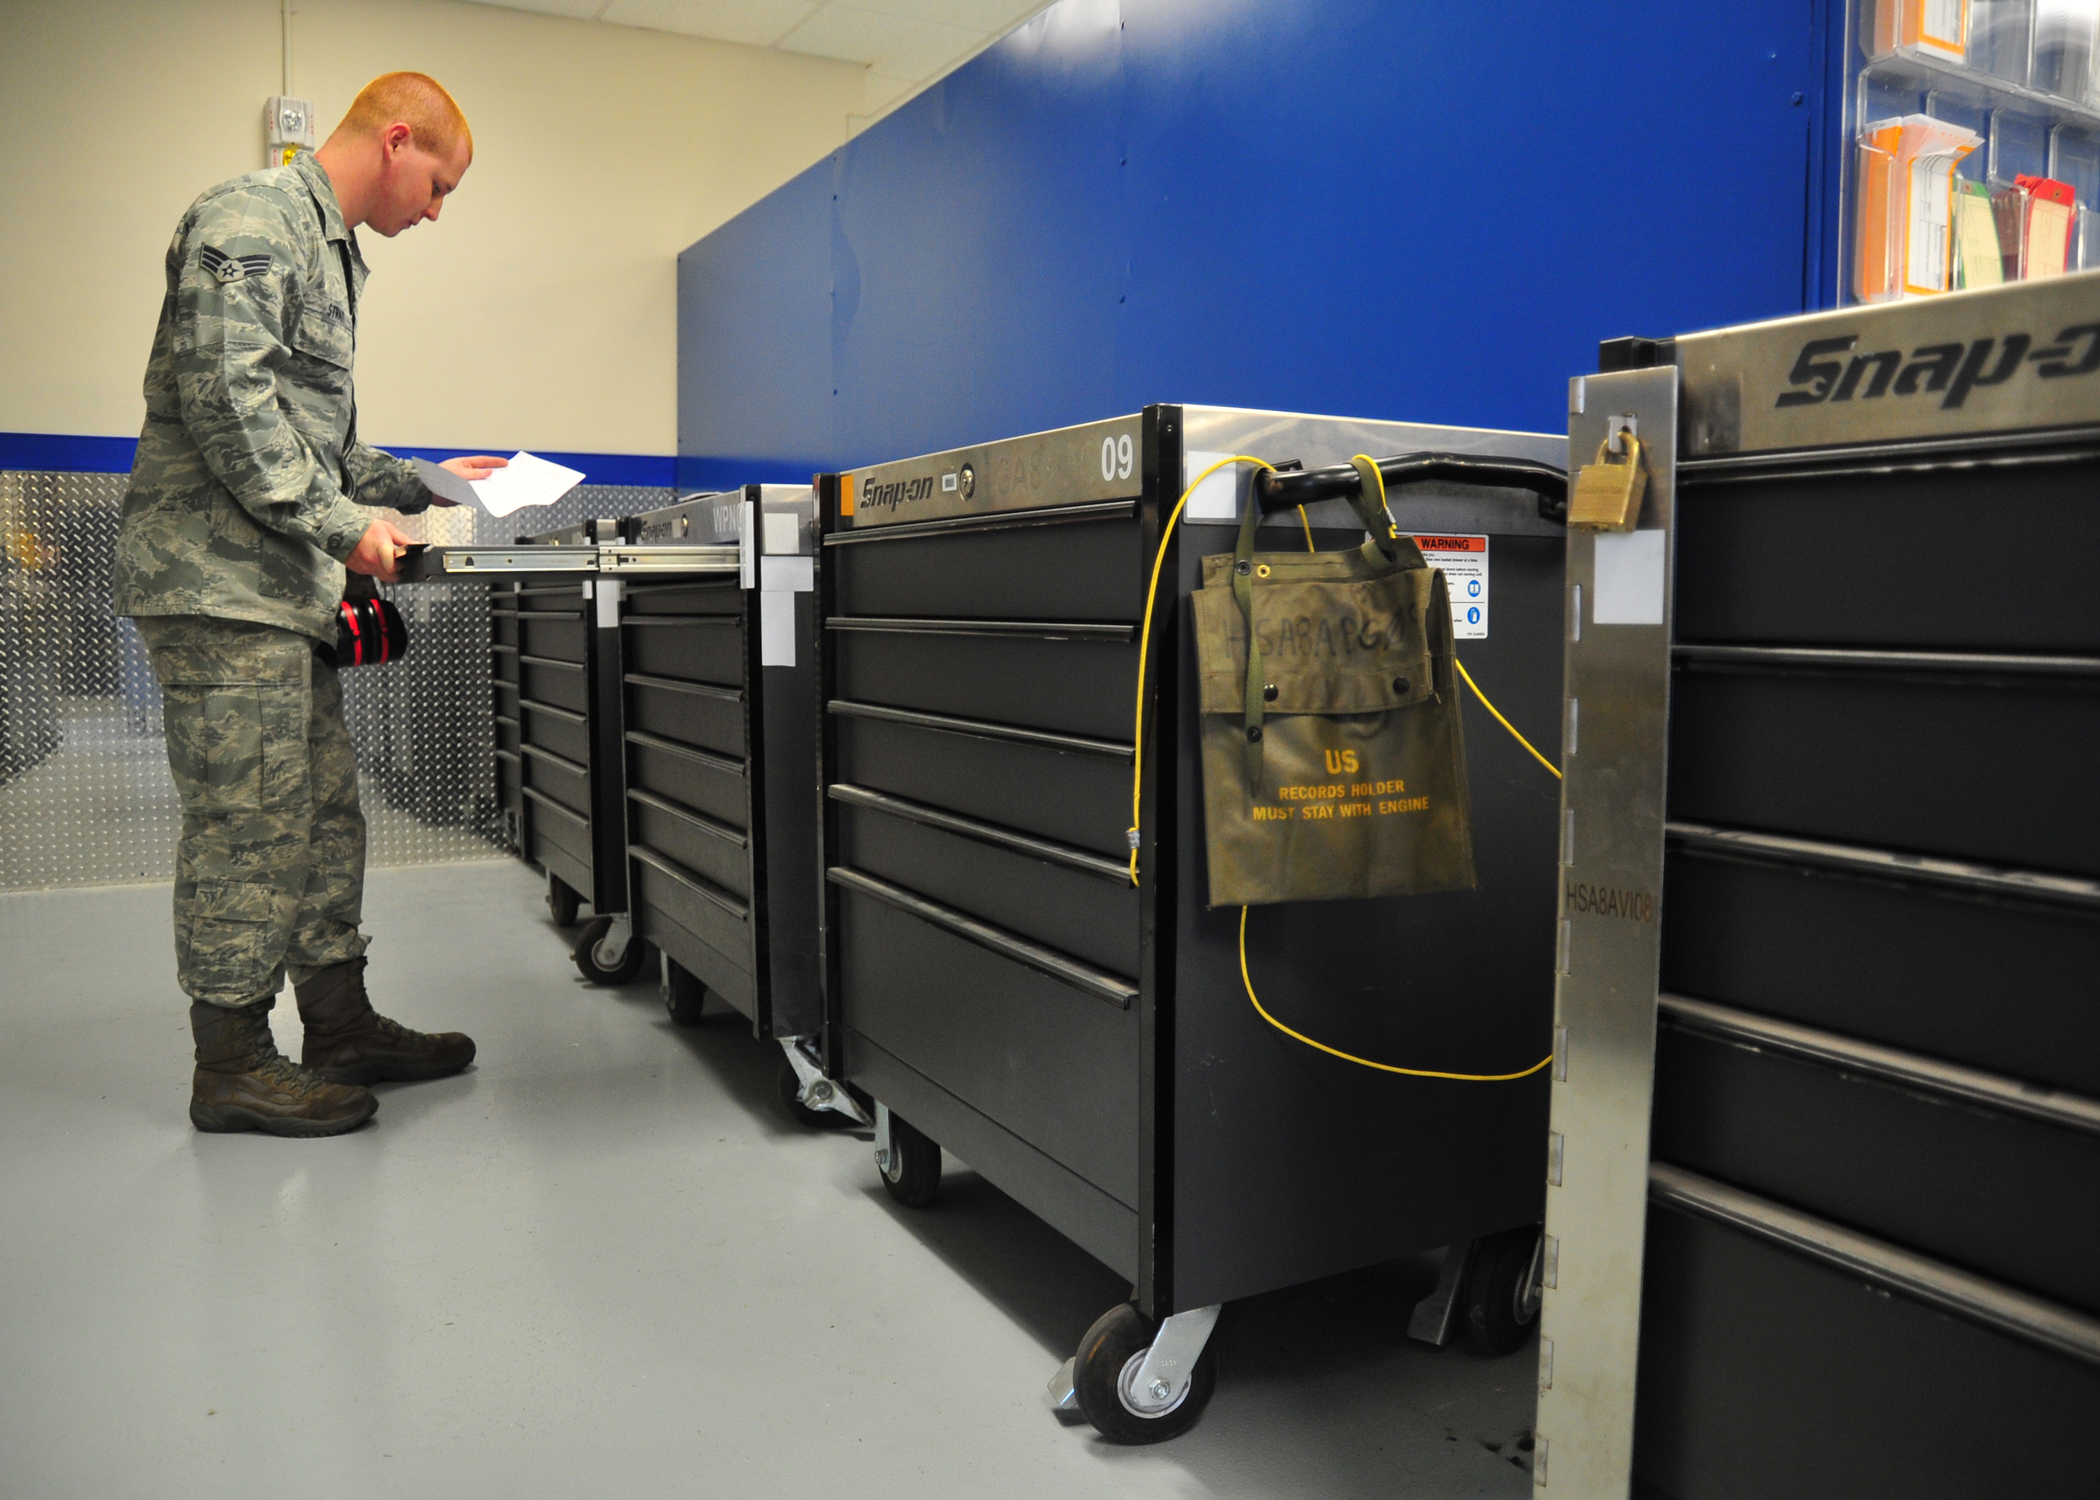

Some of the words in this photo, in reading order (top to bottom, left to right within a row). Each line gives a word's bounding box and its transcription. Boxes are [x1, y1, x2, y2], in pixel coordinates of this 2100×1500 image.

[1101, 433, 1133, 482] 09
[860, 476, 934, 512] Snap-on
[1421, 538, 1470, 550] WARNING
[1325, 749, 1359, 774] US
[1279, 784, 1345, 800] RECORDS
[1351, 780, 1405, 797] HOLDER
[1252, 806, 1294, 821] MUST
[1302, 805, 1334, 820] STAY
[1339, 803, 1371, 818] WITH
[1379, 796, 1429, 815] ENGINE
